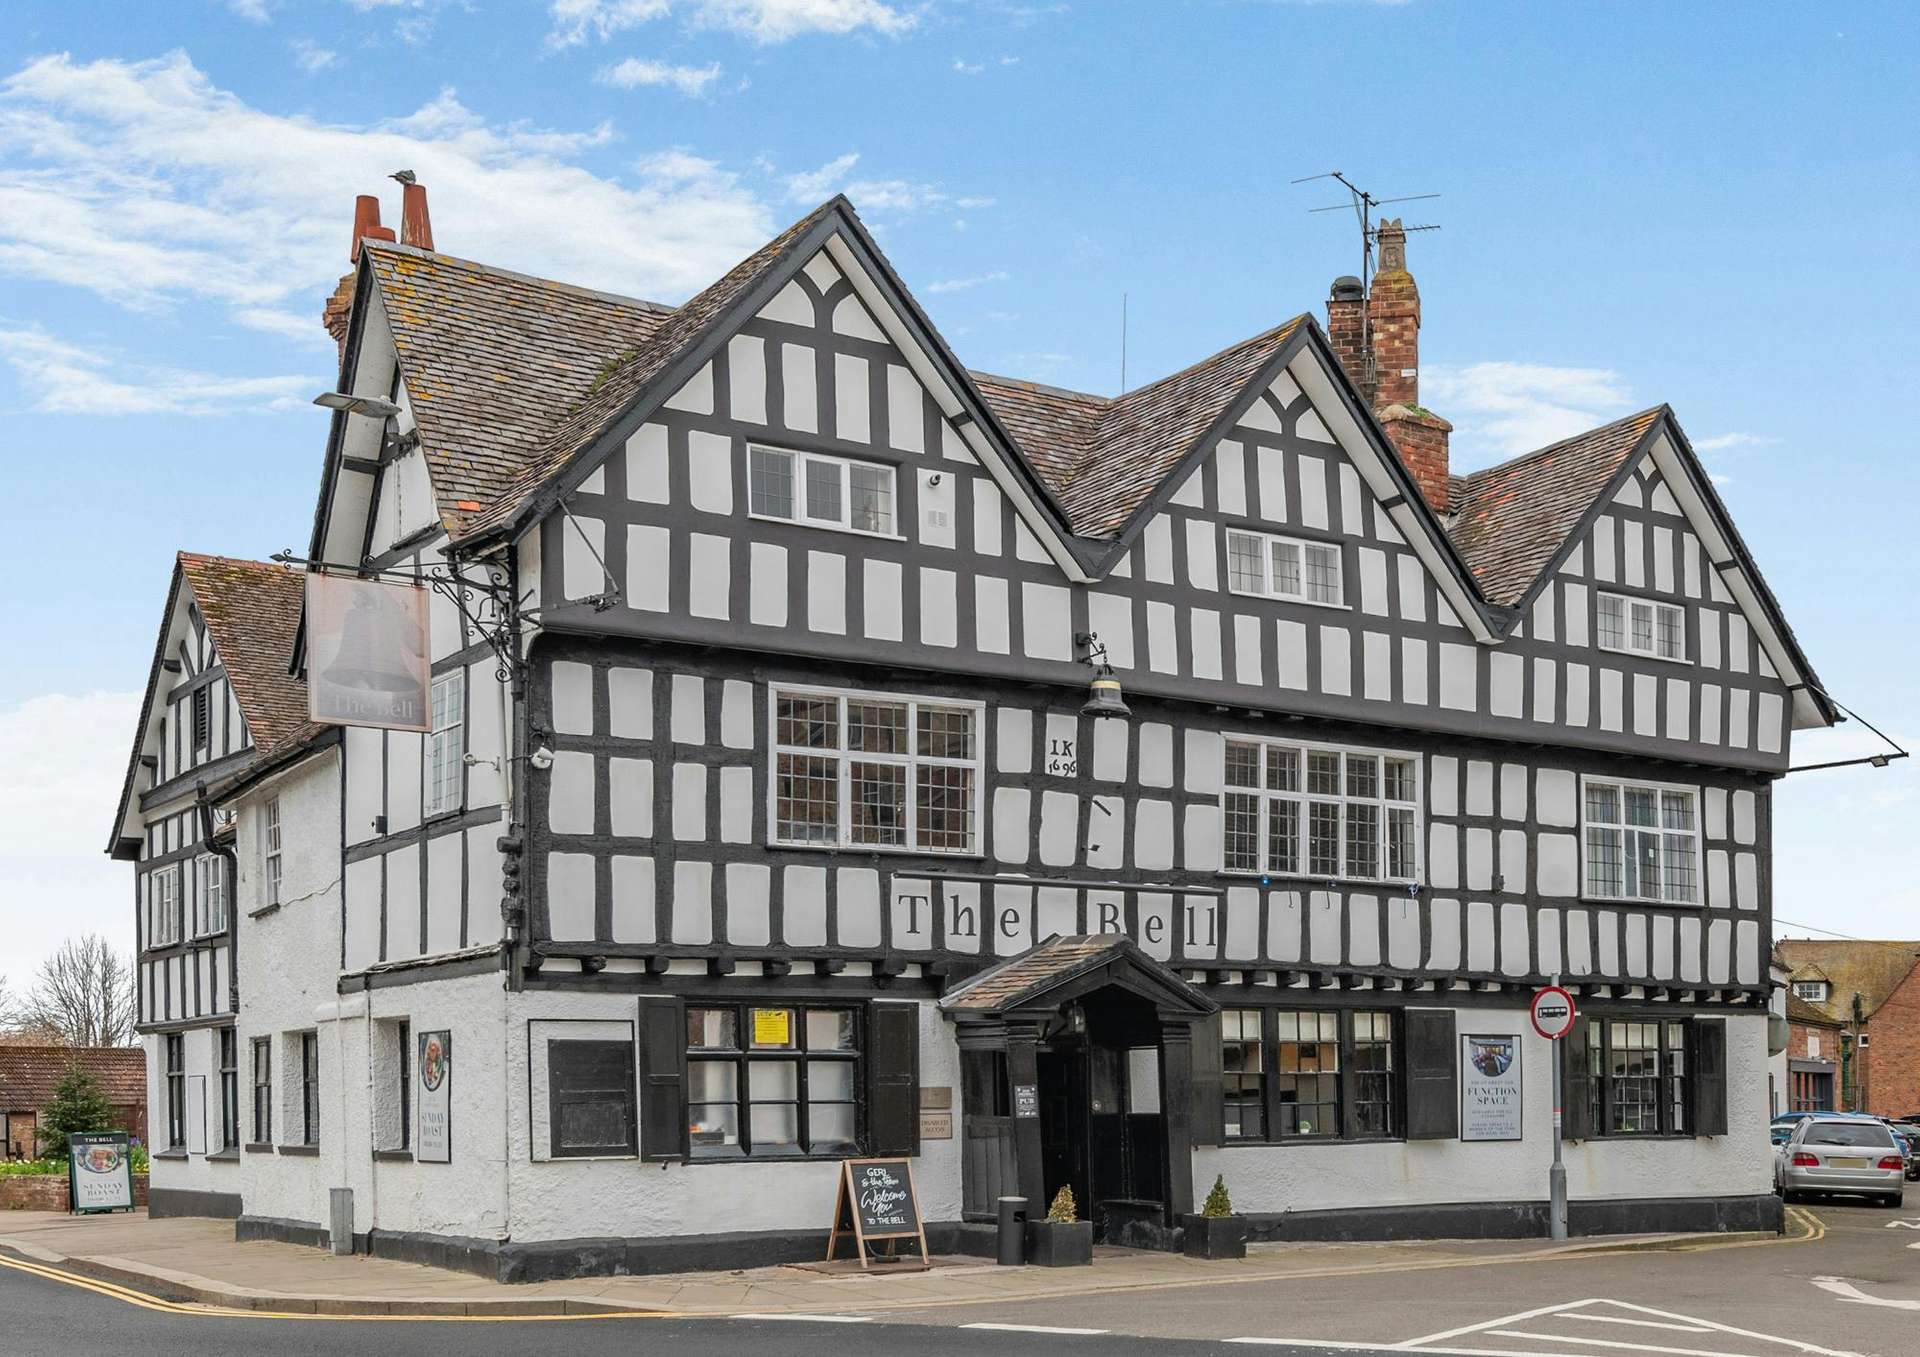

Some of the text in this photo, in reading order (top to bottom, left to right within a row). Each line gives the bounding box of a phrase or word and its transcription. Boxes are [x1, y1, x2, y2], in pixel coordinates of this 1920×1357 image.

[1049, 759, 1076, 776] 1696
[898, 895, 1217, 947] The Bell
[1467, 1087, 1517, 1096] FUNCTION
[1477, 1096, 1509, 1105] SPACE
[87, 1188, 120, 1197] ROAST
[861, 1189, 906, 1208] Welcome
[890, 1216, 906, 1224] BELL
